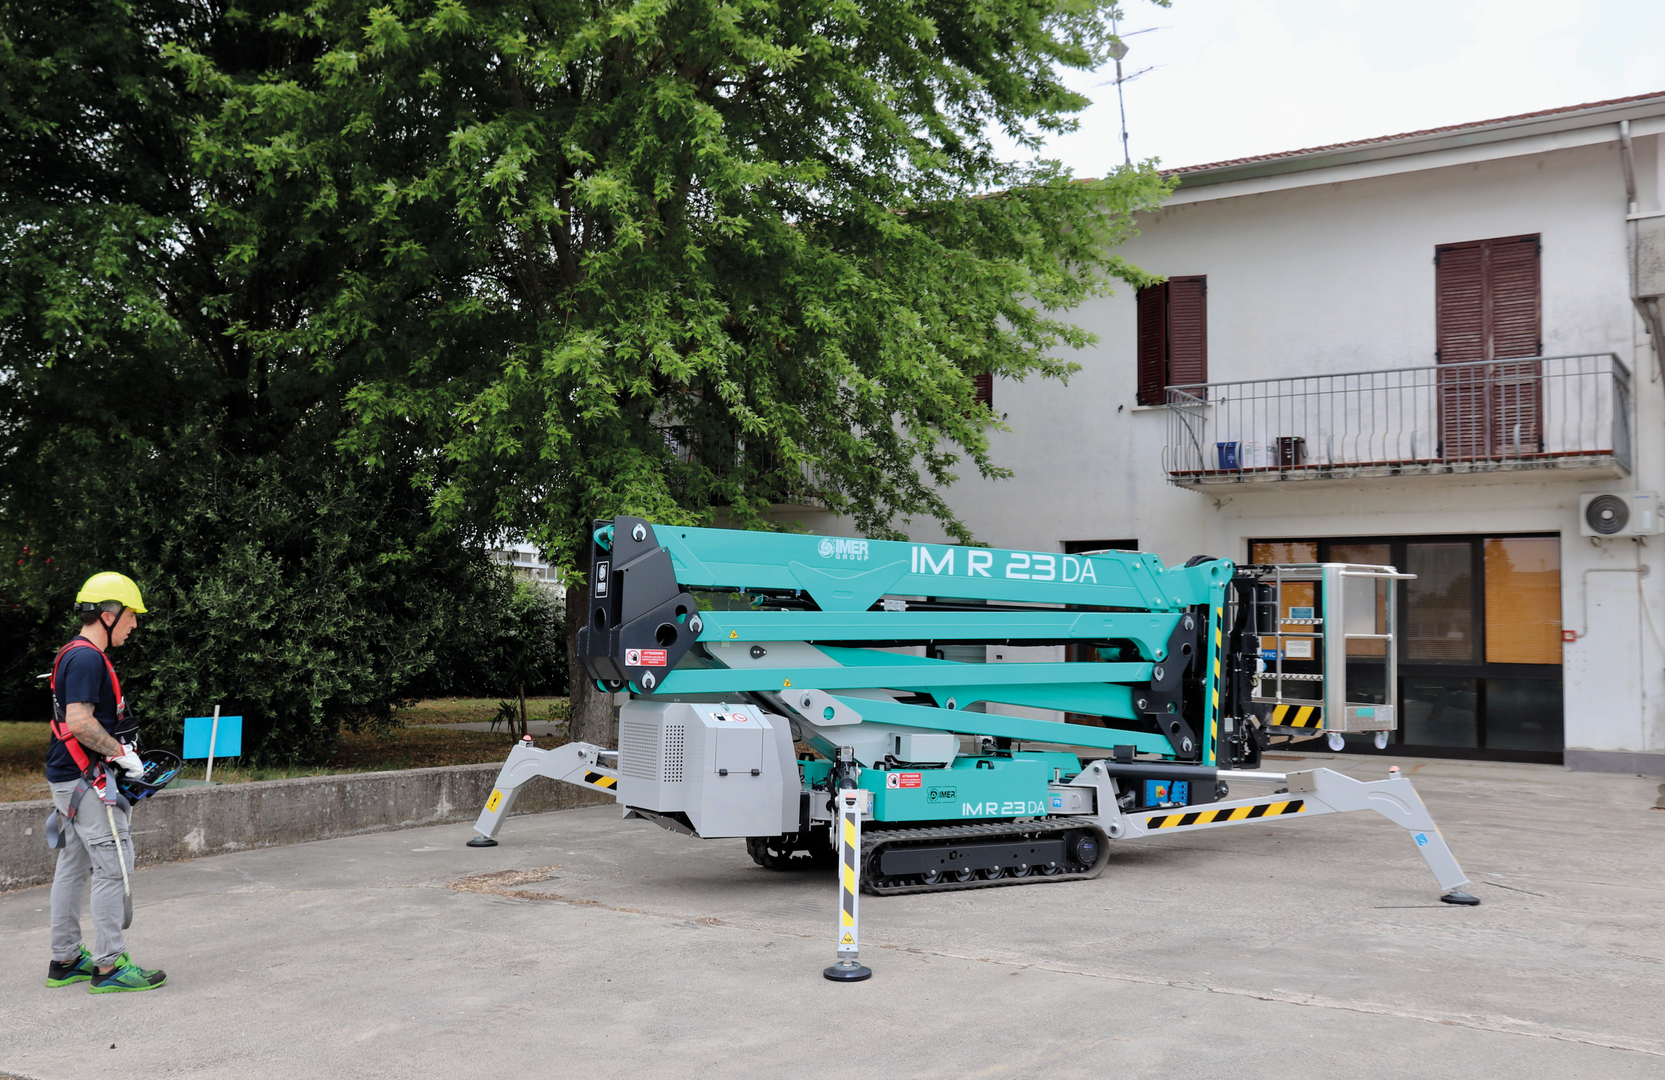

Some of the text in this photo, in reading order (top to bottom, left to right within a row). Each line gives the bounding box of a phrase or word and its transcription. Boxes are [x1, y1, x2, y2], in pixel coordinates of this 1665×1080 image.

[835, 539, 869, 555] IMER
[968, 550, 993, 577] R
[1005, 553, 1056, 581] 23
[1062, 556, 1098, 584] DA
[939, 790, 956, 799] IMER
[1001, 801, 1025, 815] 23
[1028, 801, 1046, 814] DA
